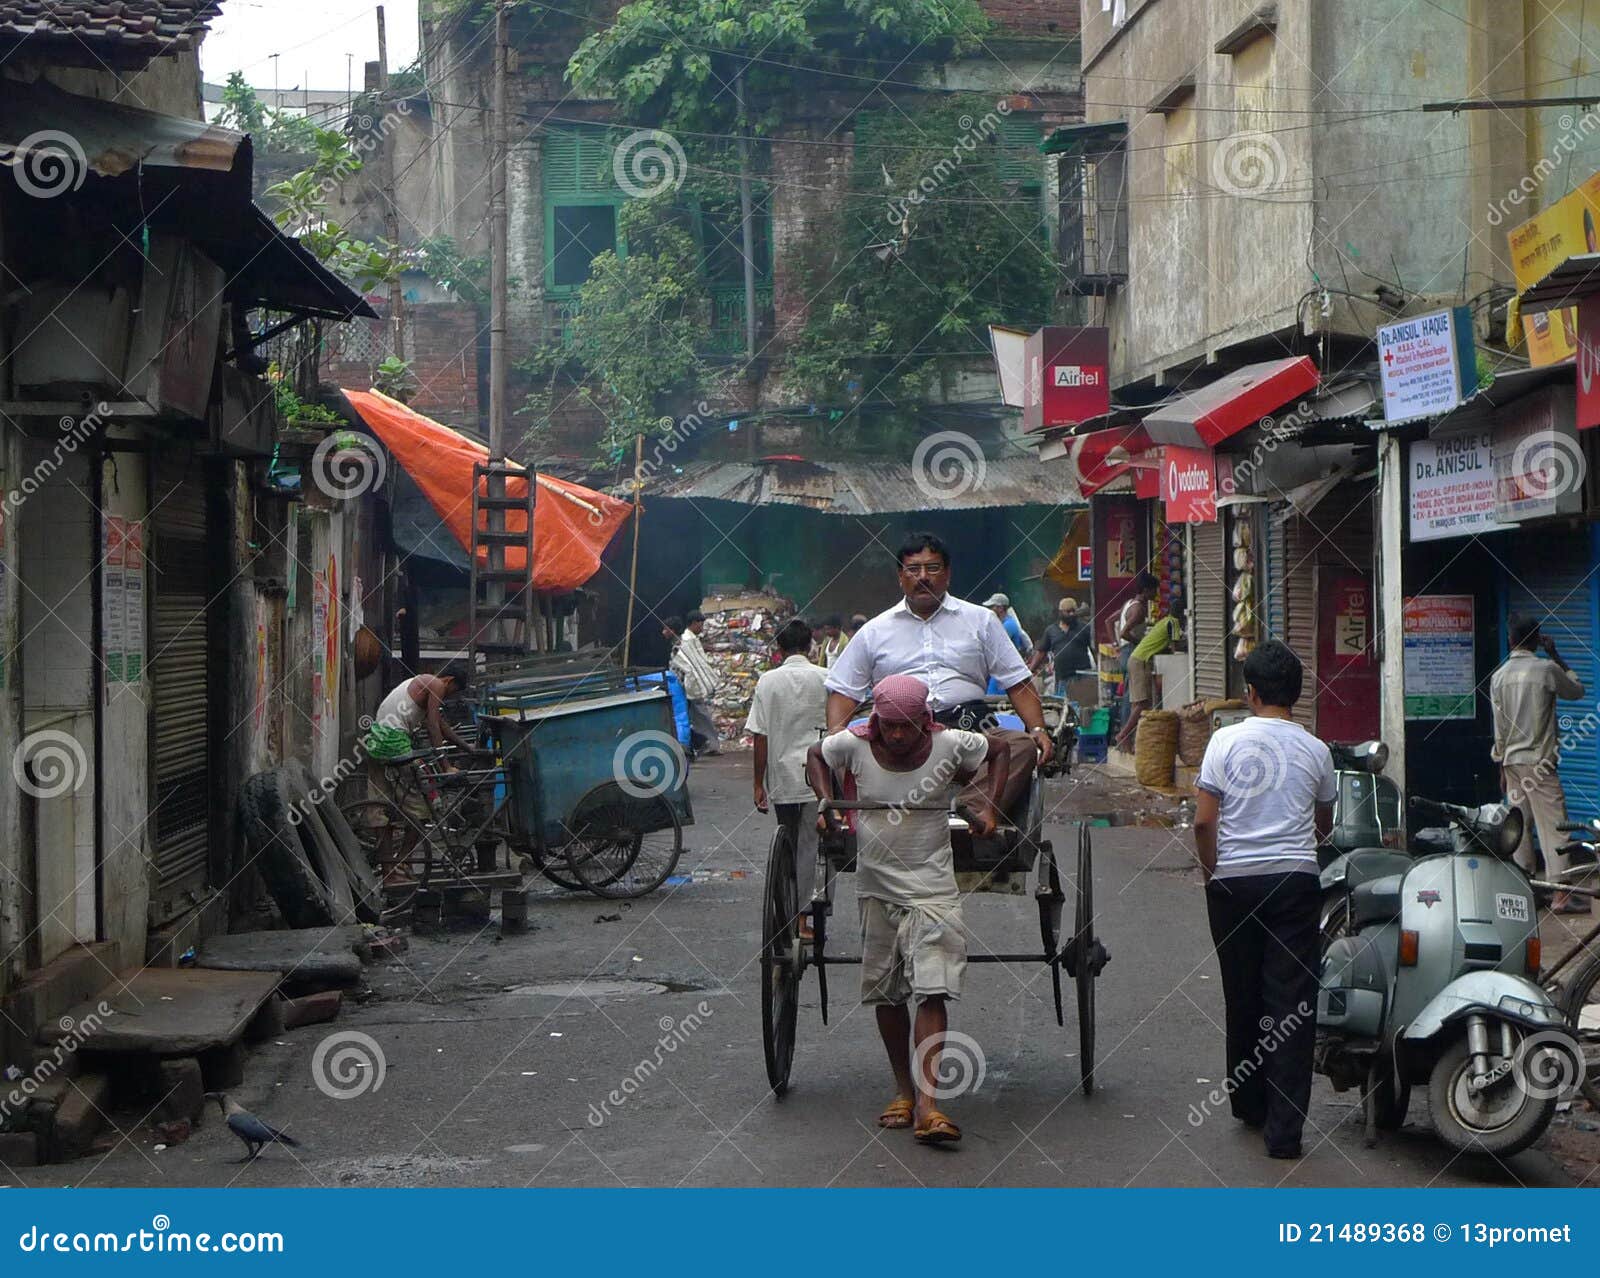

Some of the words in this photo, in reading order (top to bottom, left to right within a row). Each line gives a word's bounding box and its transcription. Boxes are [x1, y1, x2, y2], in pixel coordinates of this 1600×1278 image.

[1422, 314, 1448, 336] HAQUE
[1057, 371, 1099, 385] Airtel
[1436, 435, 1476, 457] HAQUE
[1178, 463, 1209, 491] vodafone
[1416, 488, 1441, 499] MEDICAL
[1416, 500, 1432, 510] PANEL
[1434, 497, 1455, 508] DOCTOR
[1456, 494, 1474, 504] INDIAN
[1447, 504, 1473, 516] ISLAMIA
[1459, 513, 1481, 524] STREET
[1344, 588, 1365, 650] Airtel
